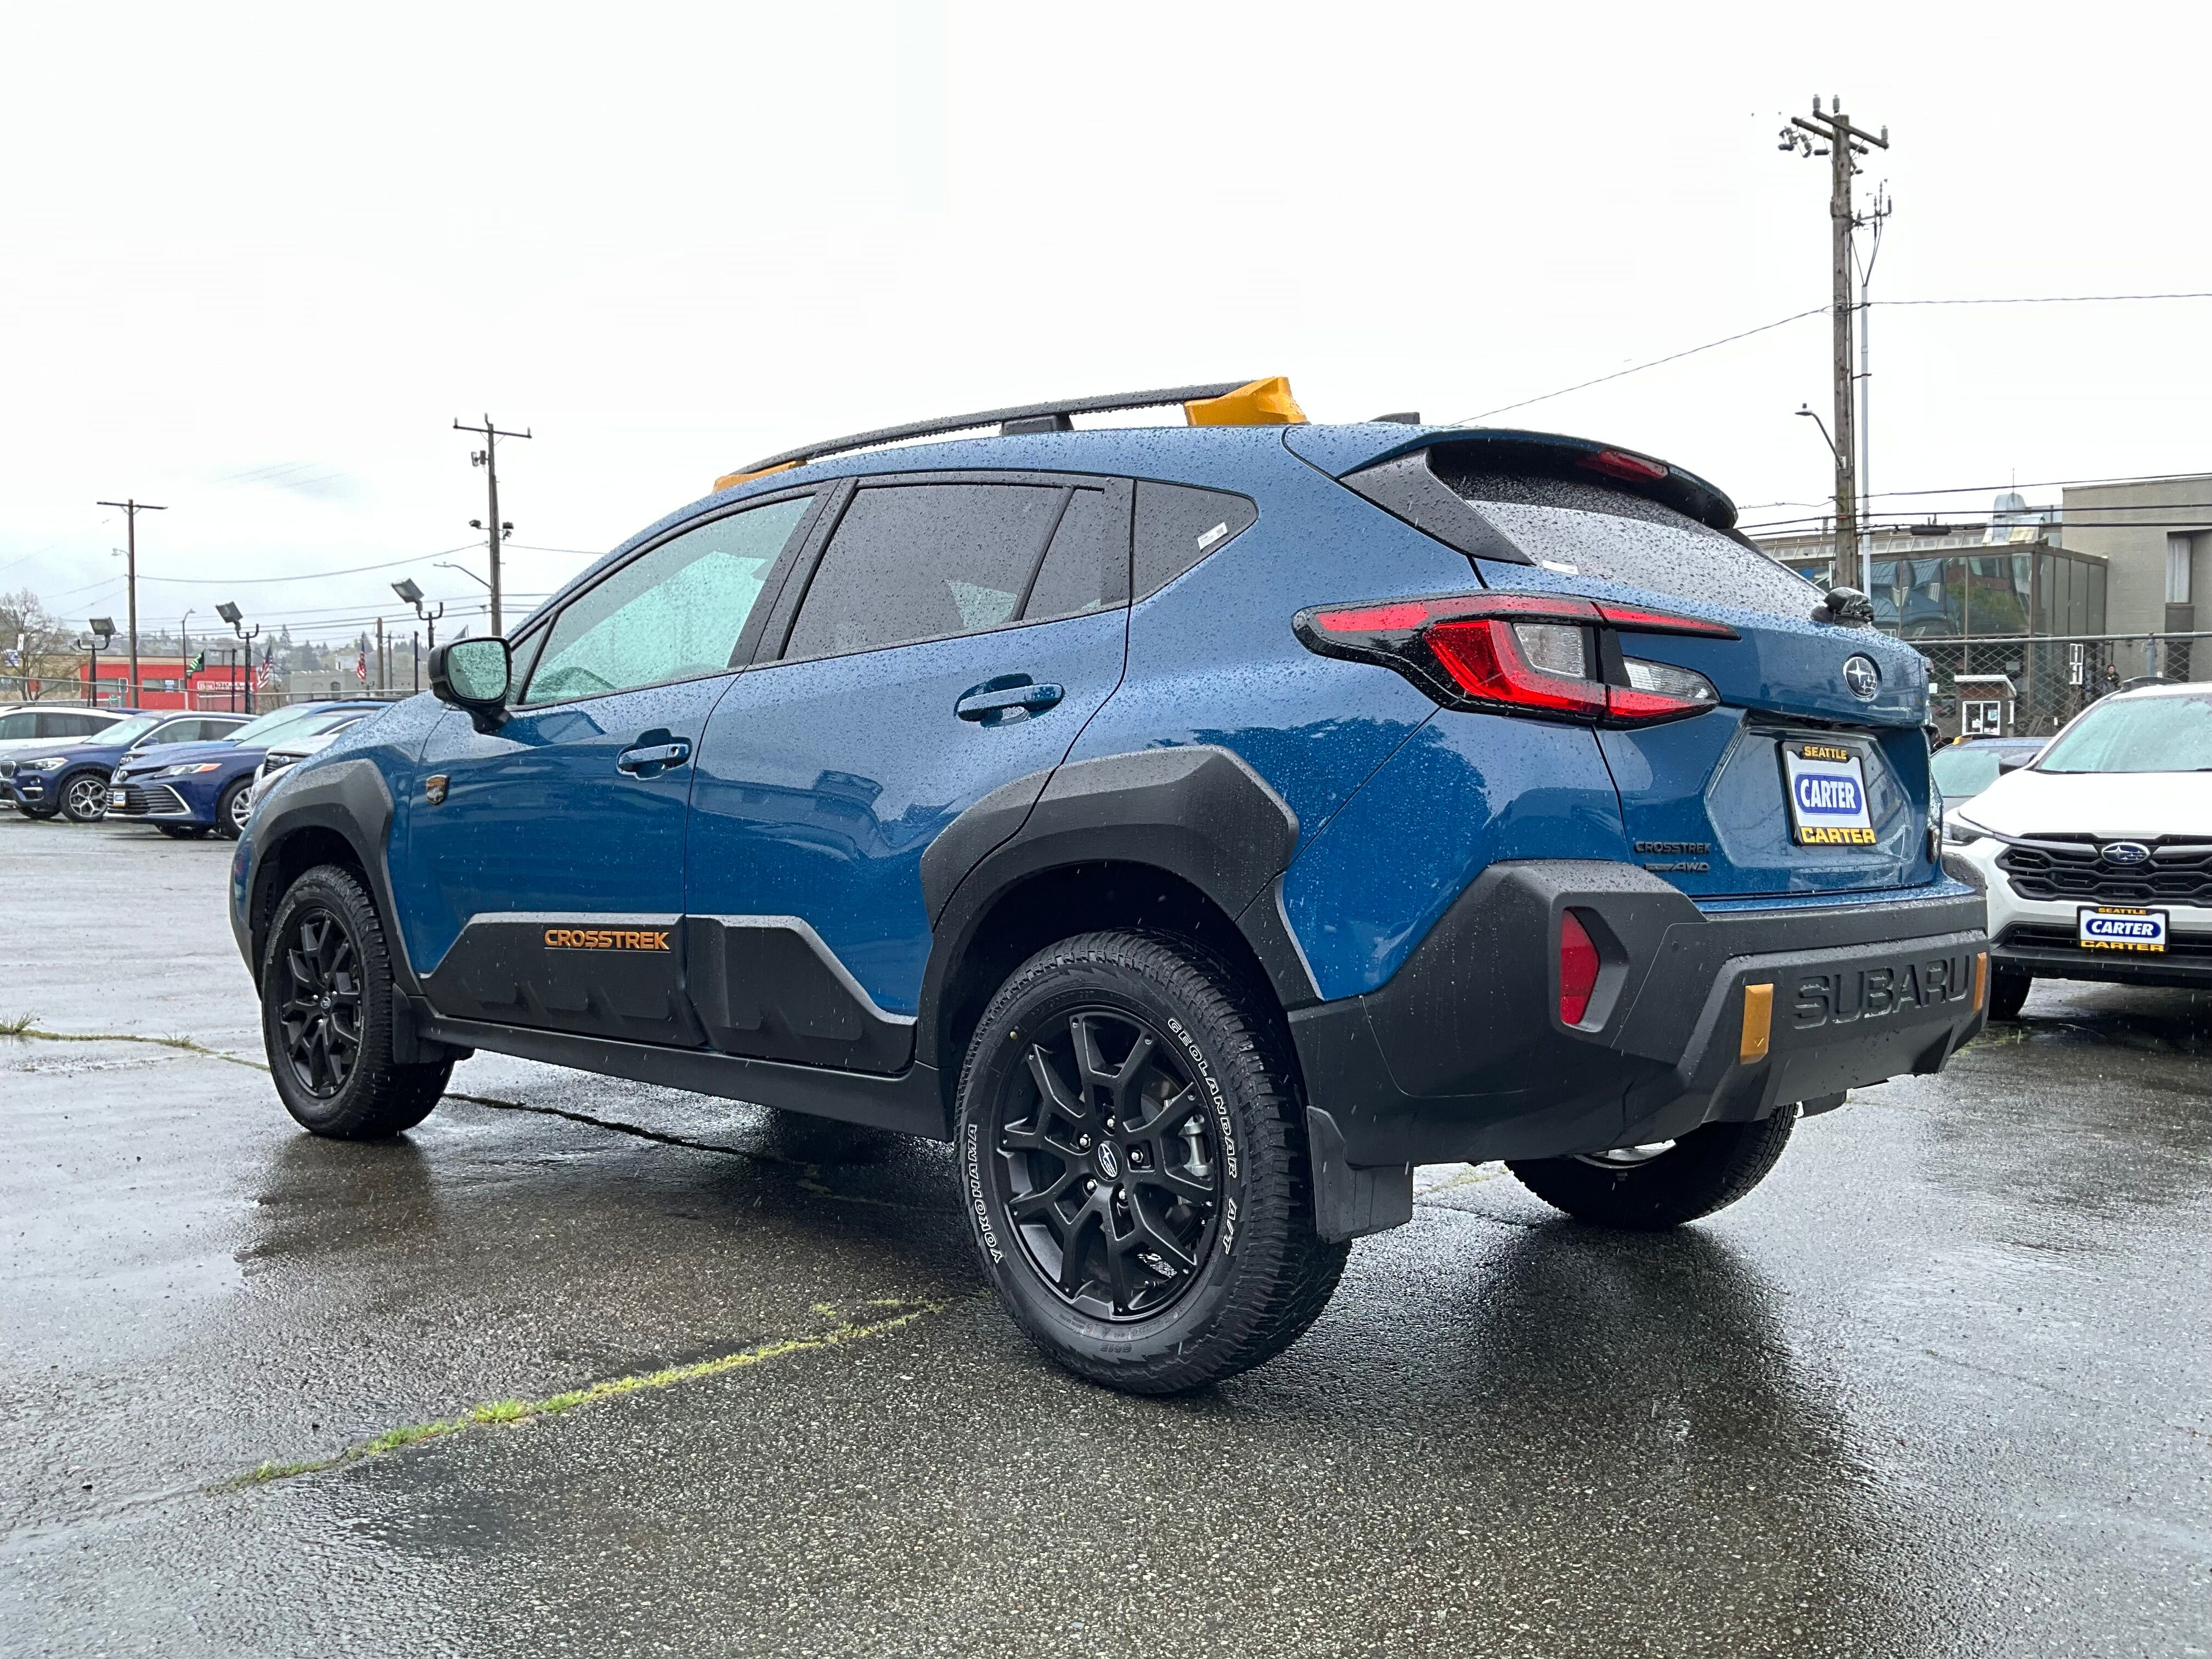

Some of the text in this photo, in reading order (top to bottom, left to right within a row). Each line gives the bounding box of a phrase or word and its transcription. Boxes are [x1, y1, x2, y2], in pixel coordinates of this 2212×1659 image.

[1804, 746, 1847, 760] SEATTLE
[1800, 778, 1857, 808] CARTER
[1801, 827, 1876, 843] CARTER
[1634, 841, 1712, 854] CROSSTREK
[1672, 862, 1711, 871] AWD
[2091, 921, 2154, 936] CARTER
[544, 929, 670, 950] CROSSTREK
[2081, 940, 2164, 952] CARTER
[1792, 955, 1970, 1029] SUBARU
[1167, 1018, 1238, 1255] GEOLANDAR A/T
[968, 1124, 1003, 1264] YOKOHAMA
